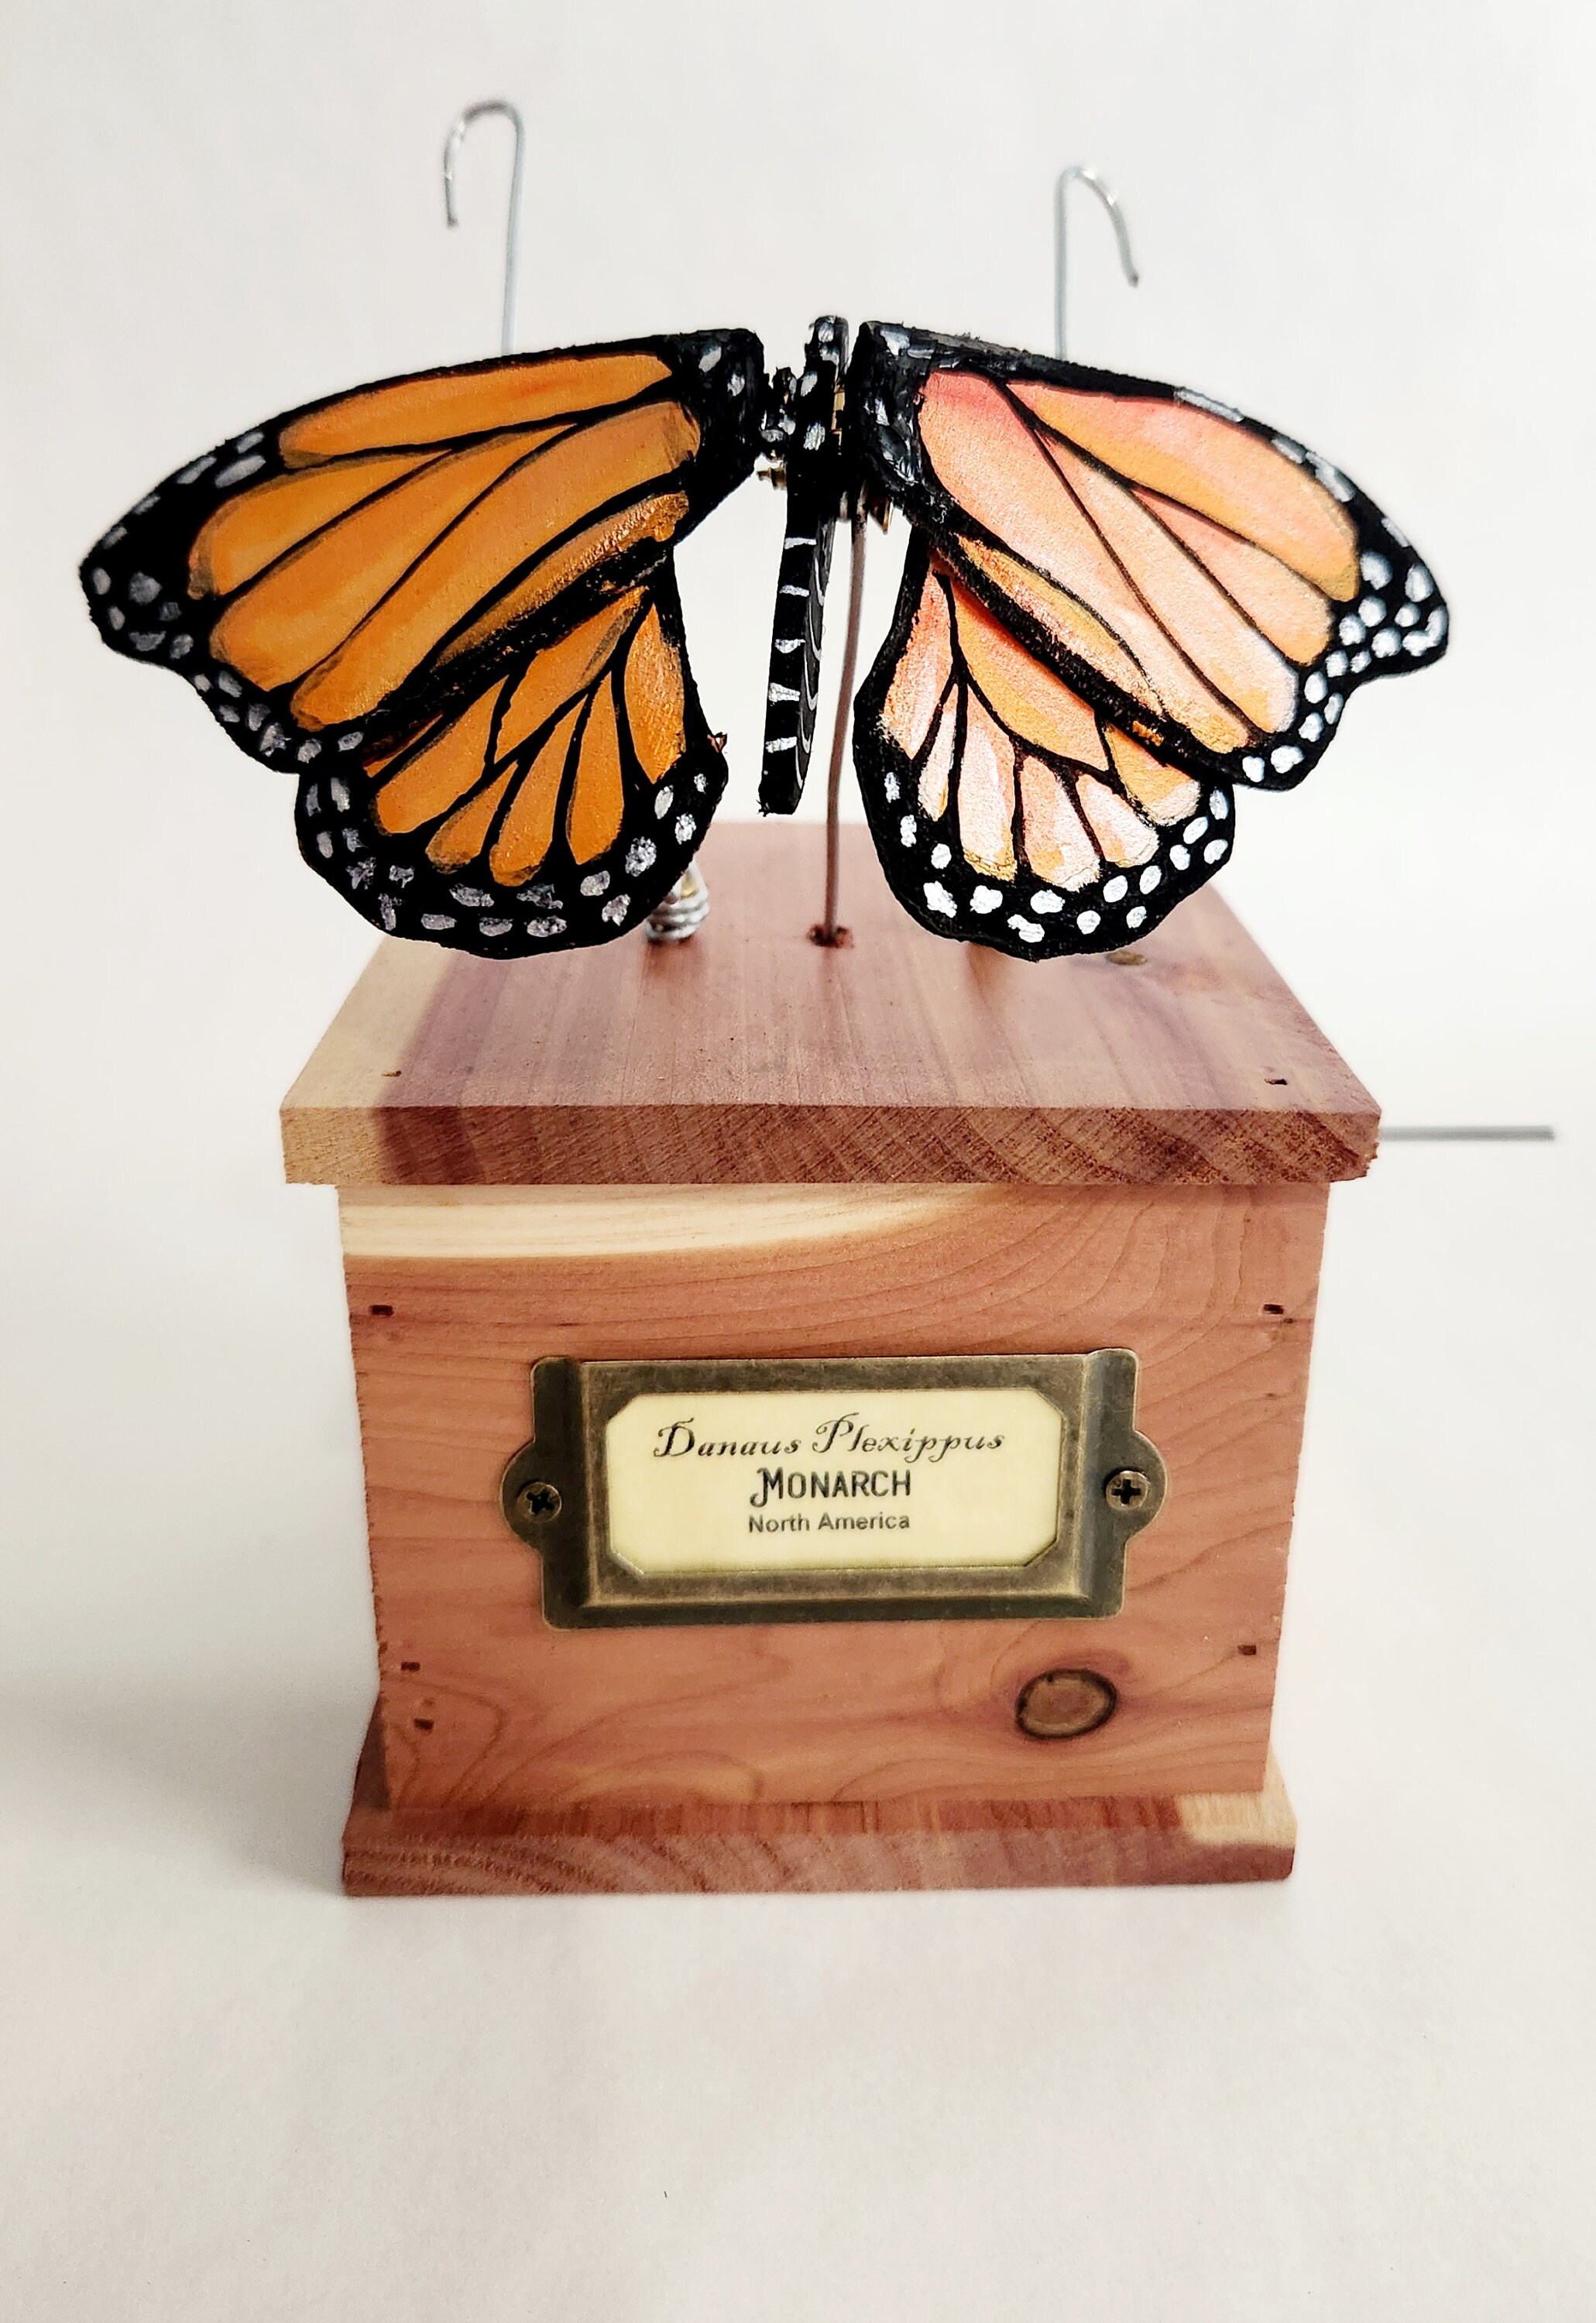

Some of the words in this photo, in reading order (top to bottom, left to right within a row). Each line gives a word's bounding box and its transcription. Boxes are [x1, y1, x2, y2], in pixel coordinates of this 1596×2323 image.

[653, 1416, 801, 1457] Danaus
[811, 1412, 1005, 1463] Plexippus
[749, 1467, 911, 1508] MONARCH
[748, 1513, 811, 1533] North
[817, 1511, 911, 1531] America
